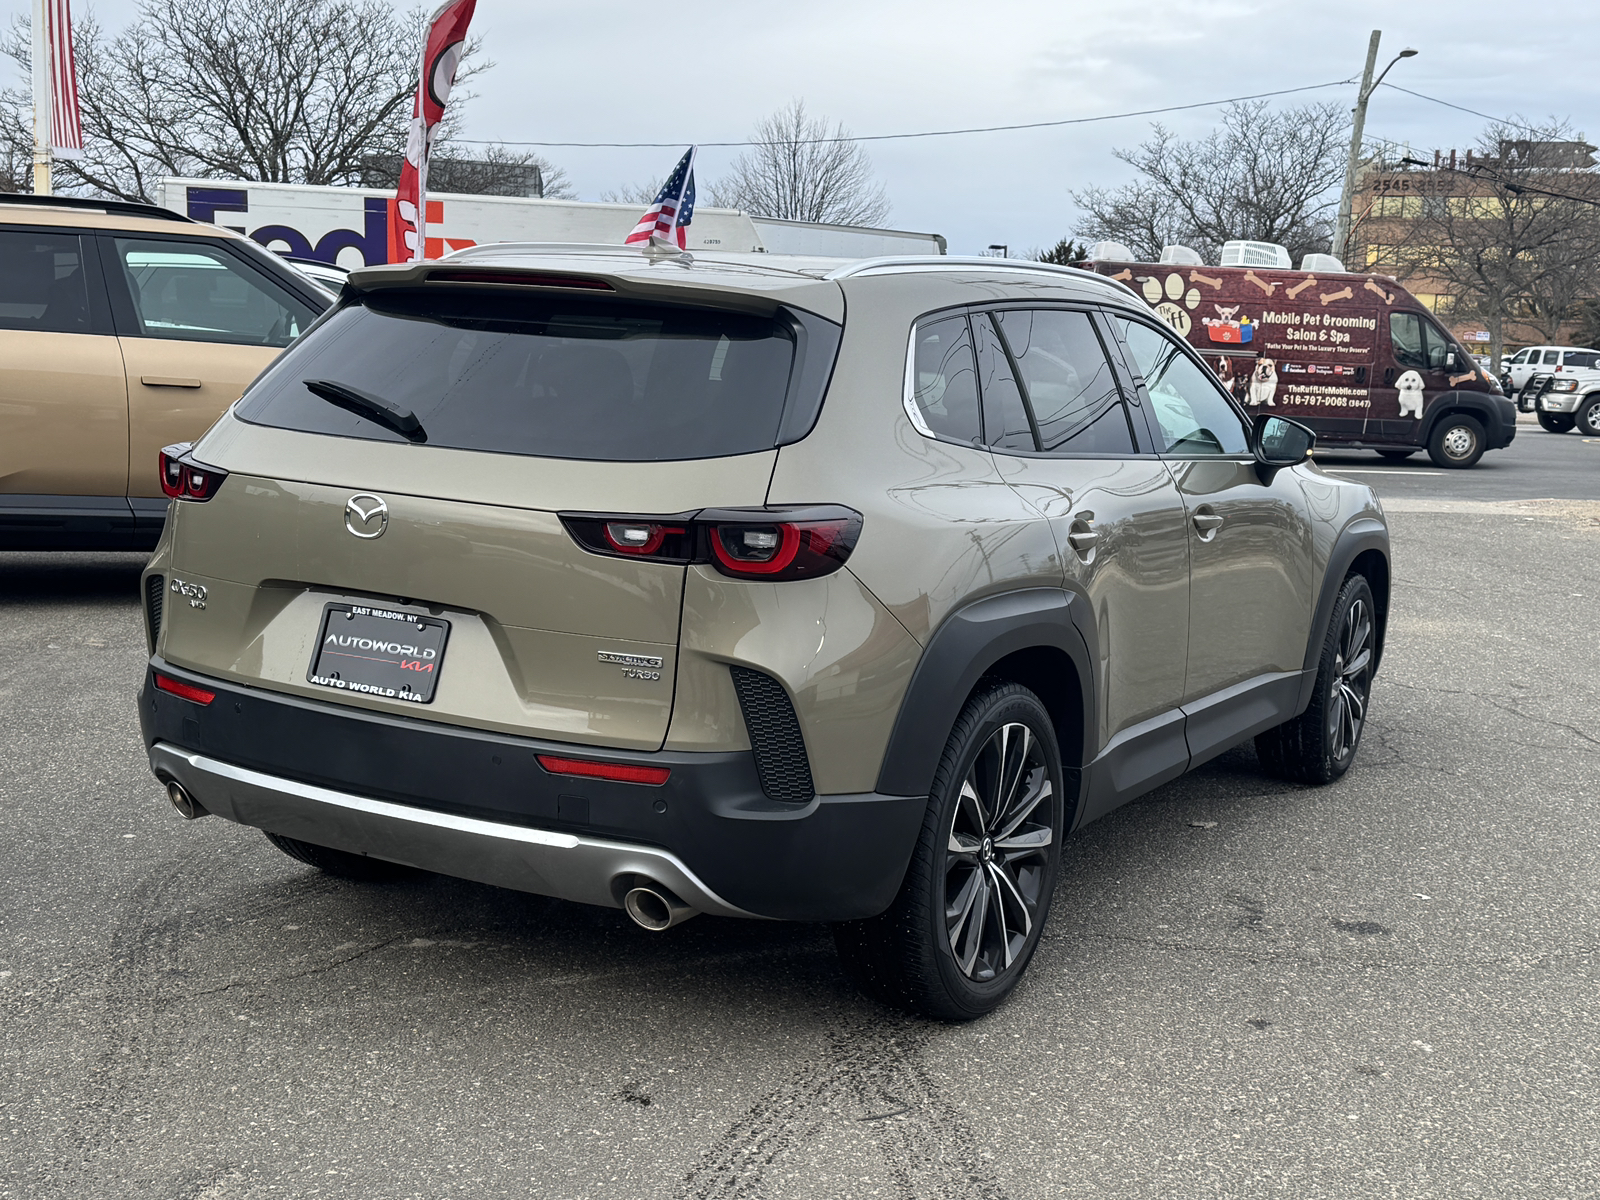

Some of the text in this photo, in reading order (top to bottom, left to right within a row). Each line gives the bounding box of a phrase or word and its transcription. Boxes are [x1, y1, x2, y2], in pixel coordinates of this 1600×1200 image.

[1373, 179, 1409, 191] 2545
[1158, 305, 1171, 315] The
[1262, 311, 1376, 330] Mobile Pet Grooming
[1286, 327, 1350, 344] Salon & Spa
[1309, 344, 1317, 352] The
[1287, 384, 1368, 396] TheRuffLifeMobile.com
[1282, 394, 1371, 408] 516-797-DOGS (3647)
[171, 579, 208, 601] CX-50
[352, 606, 370, 616] EAST
[407, 614, 418, 623] NY
[325, 633, 436, 660] AUTOWORLD
[621, 667, 660, 680] TURBO
[311, 675, 423, 702] AUTO WORLD KIA
